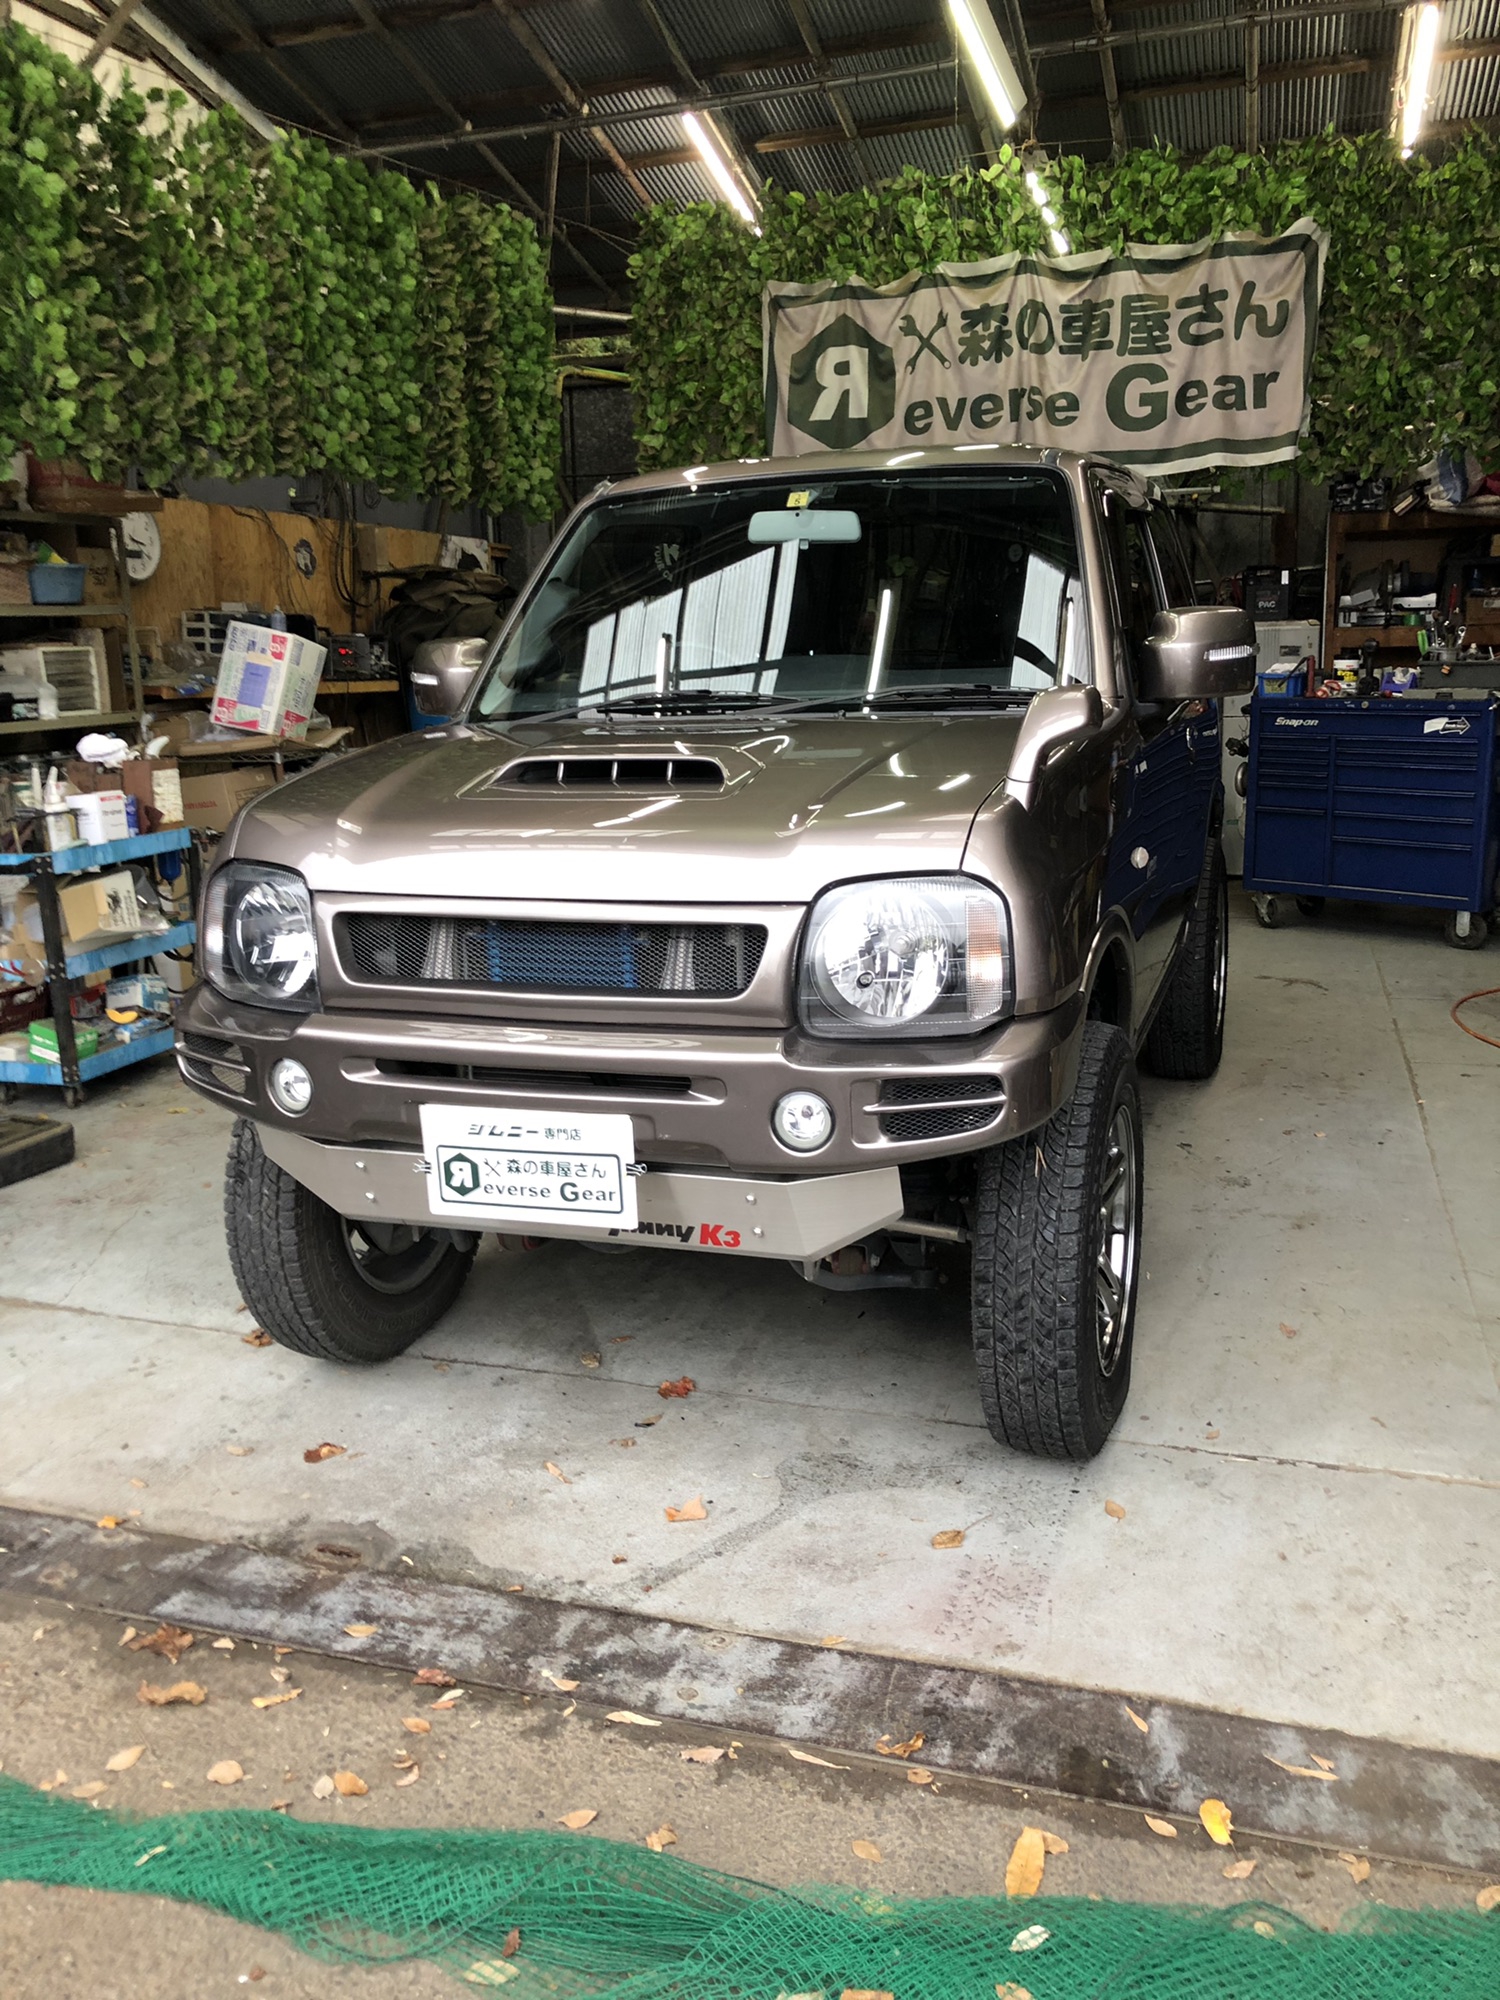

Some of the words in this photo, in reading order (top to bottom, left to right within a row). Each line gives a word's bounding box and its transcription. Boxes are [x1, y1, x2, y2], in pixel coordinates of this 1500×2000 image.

[957, 280, 1290, 366] 森の車屋さん
[1105, 362, 1281, 433] Gear
[1274, 716, 1320, 728] Snap-on
[506, 1158, 607, 1180] 森の車屋さん
[559, 1181, 616, 1203] Gear
[699, 1223, 741, 1248] K3
